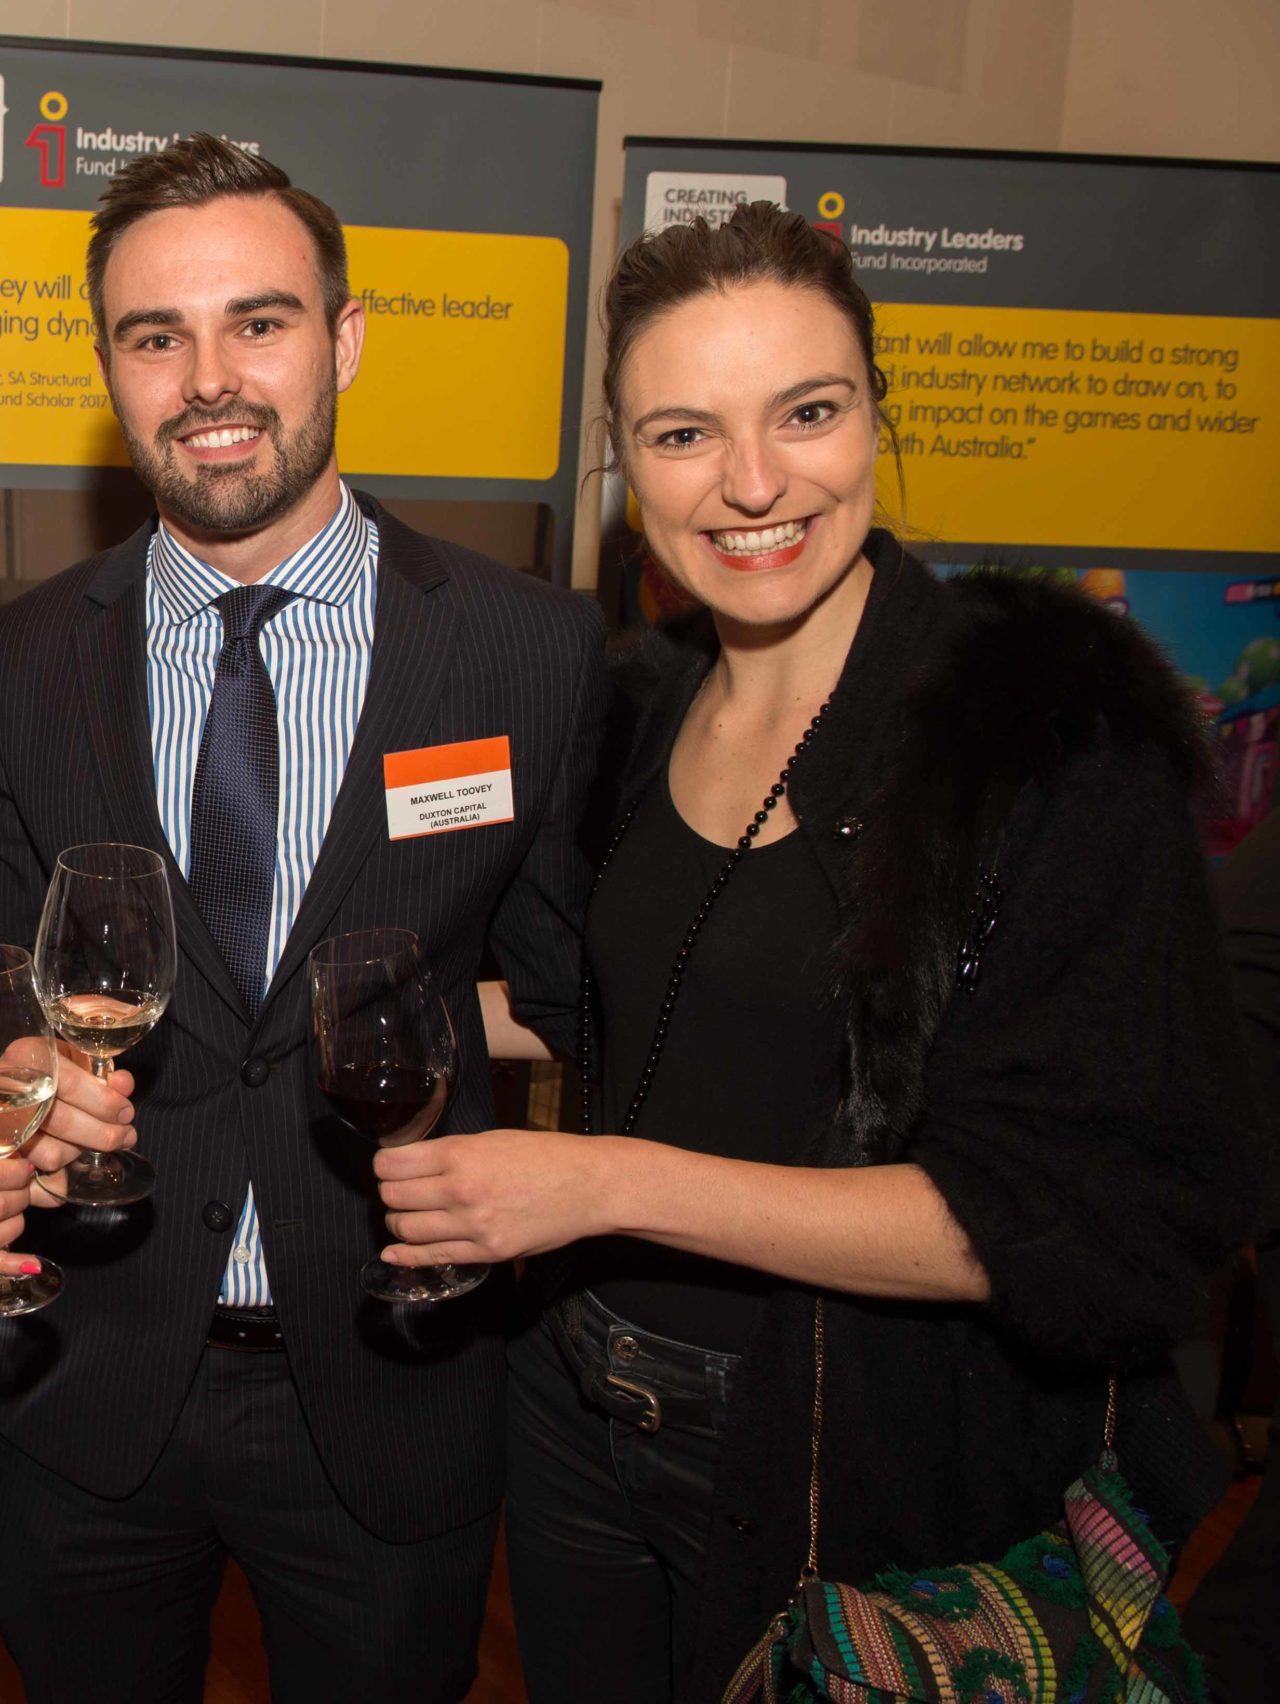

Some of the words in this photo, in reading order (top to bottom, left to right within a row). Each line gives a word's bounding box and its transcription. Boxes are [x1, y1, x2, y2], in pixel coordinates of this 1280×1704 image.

[76, 127, 168, 153] Industry
[76, 157, 116, 177] Fund
[665, 188, 747, 204] CREATING
[664, 208, 735, 223] INDUST
[850, 224, 935, 252] Industry
[941, 227, 1024, 251] Leaders
[891, 253, 988, 274] Incorporated
[34, 275, 71, 300] will
[442, 293, 512, 320] leader
[876, 333, 911, 353] ant
[917, 332, 952, 354] will
[958, 333, 1017, 357] allow
[1022, 341, 1058, 360] me
[1064, 339, 1085, 361] to
[1091, 338, 1144, 363] build
[1149, 346, 1165, 364] a
[1171, 344, 1239, 373] strong
[9, 371, 25, 384] SA
[30, 372, 92, 387] Structural
[901, 365, 988, 396] industry
[993, 371, 1081, 394] network
[1087, 374, 1107, 396] to
[1113, 373, 1171, 397] draw
[1176, 381, 1208, 402] on,
[1216, 378, 1237, 400] to
[26, 393, 75, 407] Scholar
[80, 394, 108, 408] 2017
[909, 401, 984, 428] impact
[989, 407, 1018, 425] on
[1024, 403, 1058, 427] the
[1064, 410, 1141, 434] games
[1147, 409, 1192, 432] and
[1197, 410, 1260, 434] wider
[410, 790, 454, 805] MAXWELL
[457, 783, 493, 797] TOOVEY
[419, 808, 452, 821] DUXTON
[454, 802, 487, 815] CAPITAL
[430, 813, 480, 829] (AUSTRALIA)
